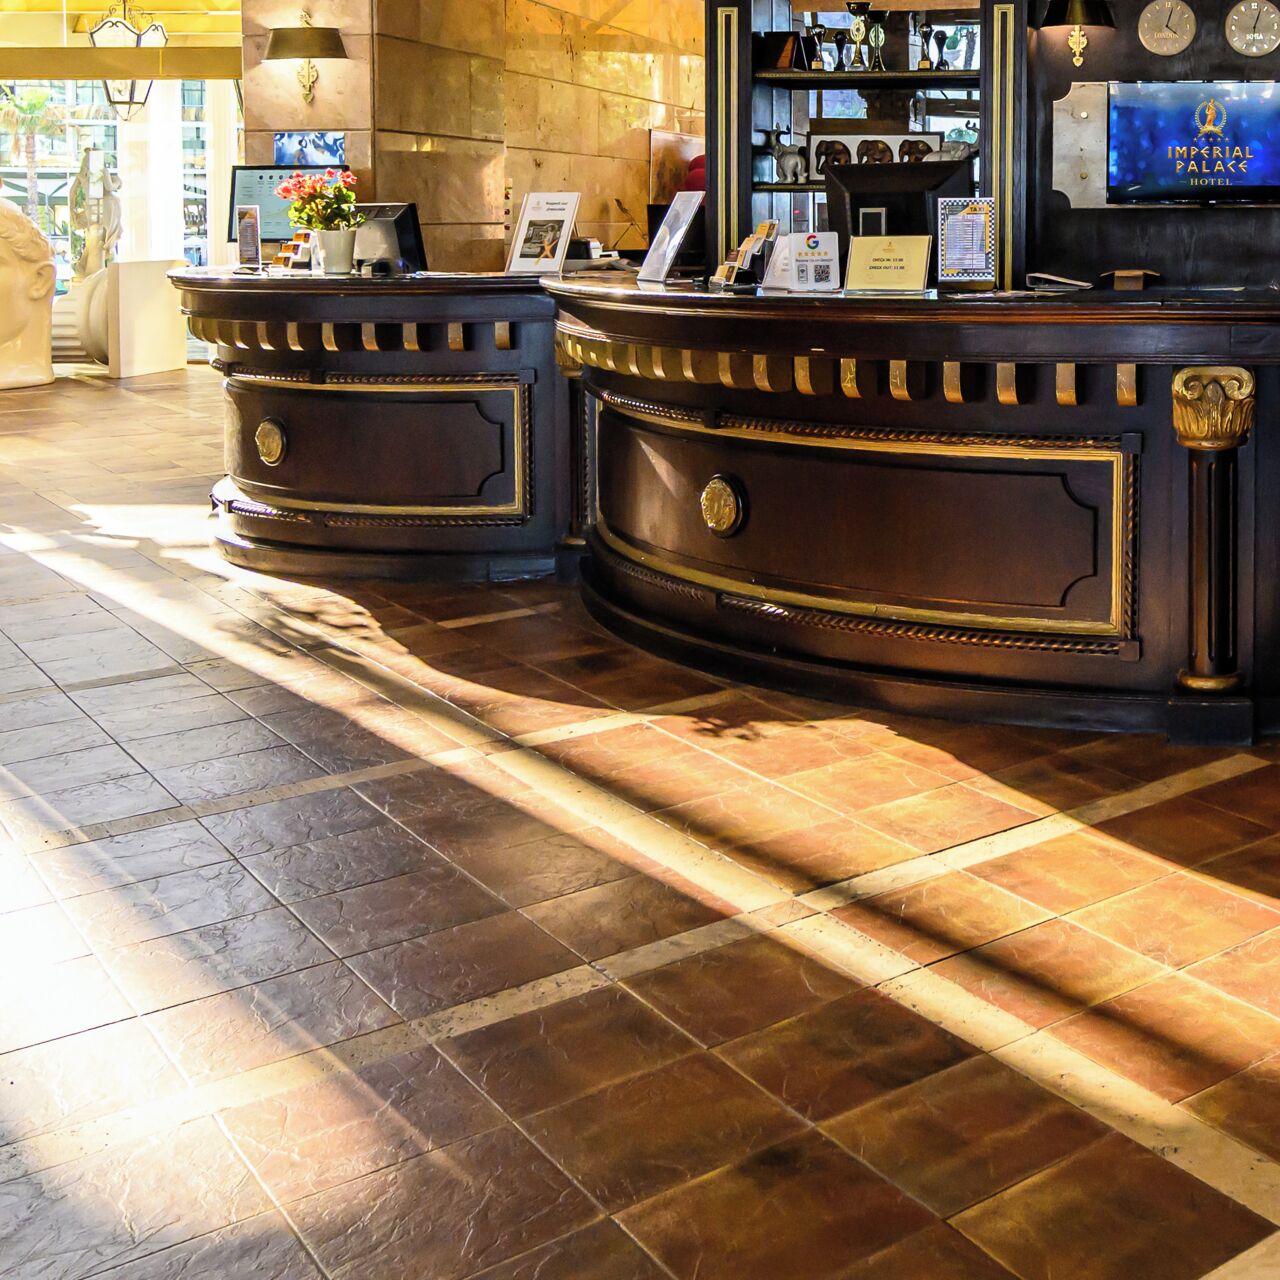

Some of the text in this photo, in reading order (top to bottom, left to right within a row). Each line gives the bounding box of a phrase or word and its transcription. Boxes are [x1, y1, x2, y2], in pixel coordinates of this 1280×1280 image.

[1167, 146, 1255, 159] IMPERIAL
[1175, 160, 1248, 173] PALACE
[1190, 178, 1233, 186] HOTEL
